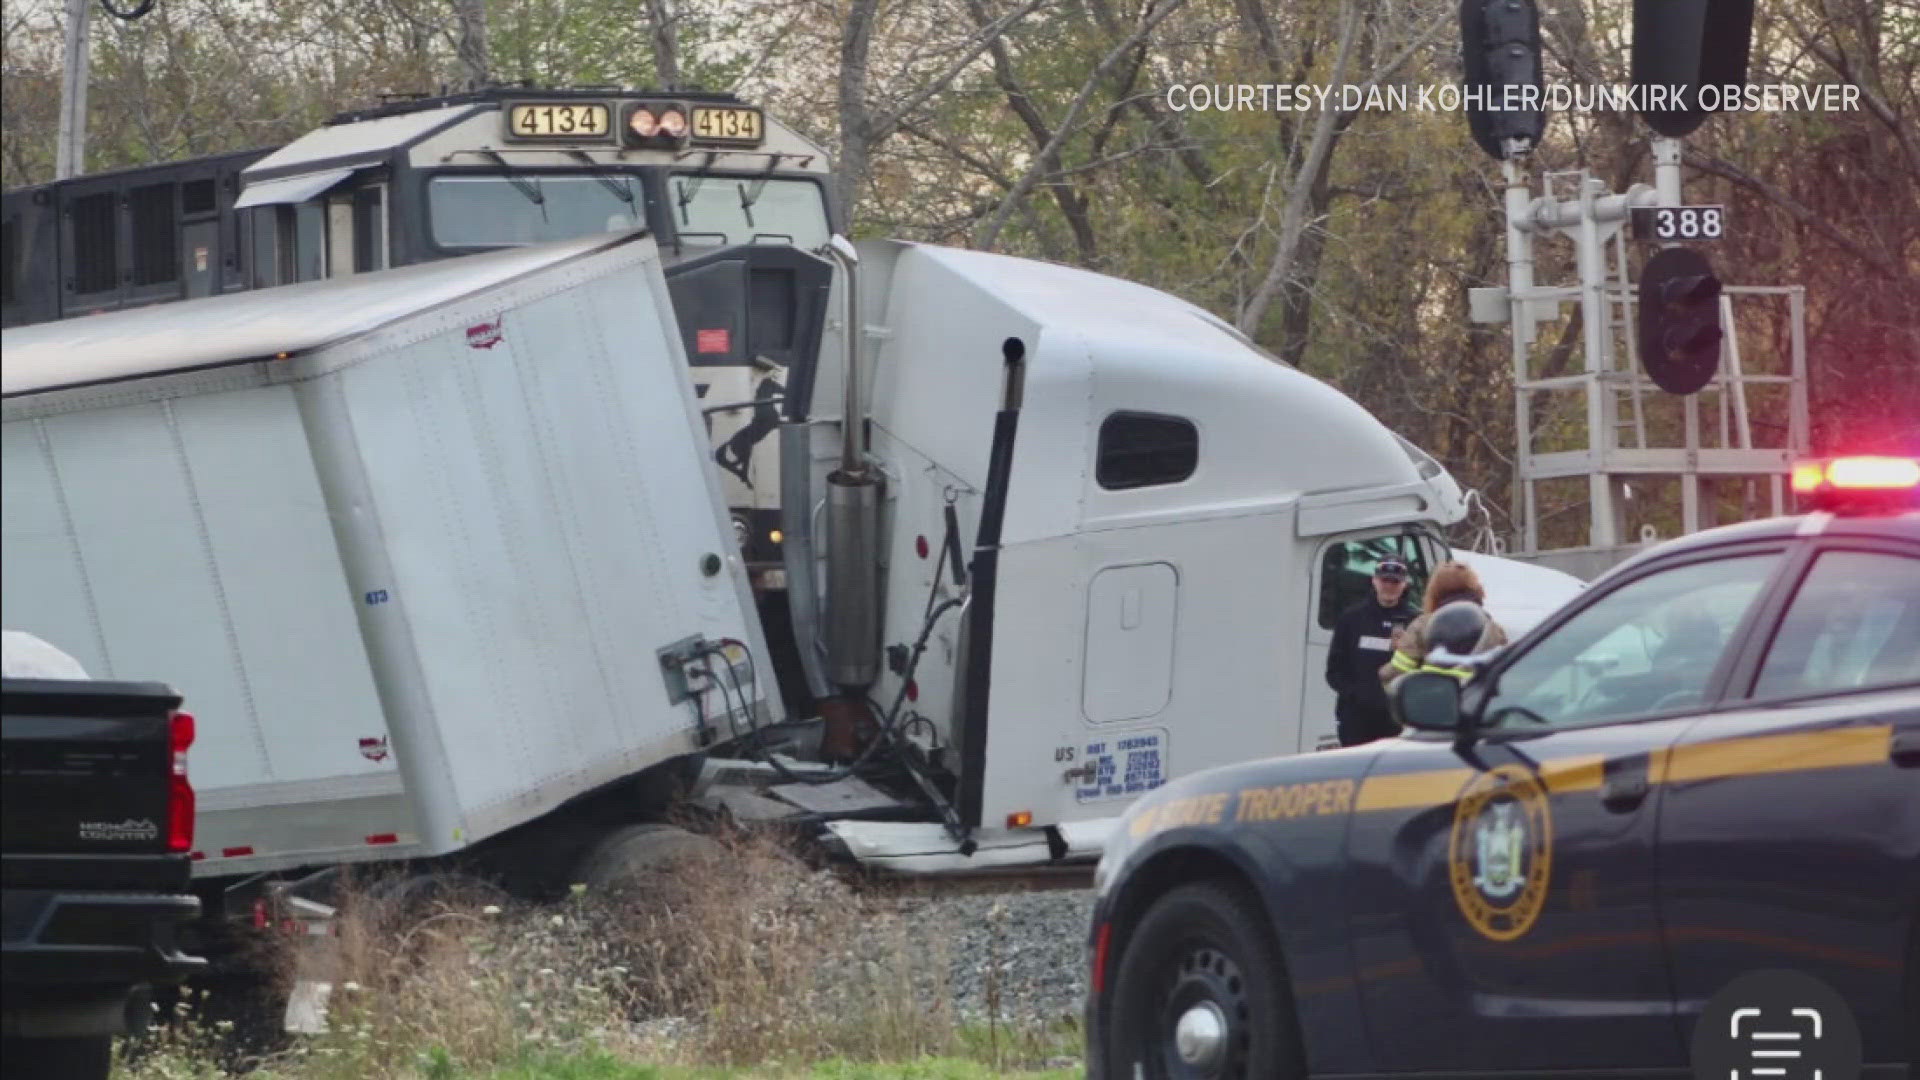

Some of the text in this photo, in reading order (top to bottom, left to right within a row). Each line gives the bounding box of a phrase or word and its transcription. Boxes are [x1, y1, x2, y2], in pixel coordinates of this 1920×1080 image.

[521, 107, 598, 133] 4134
[699, 109, 755, 136] 4134
[1657, 209, 1722, 237] 388
[1055, 746, 1075, 761] US
[1235, 778, 1355, 823] TROOPER
